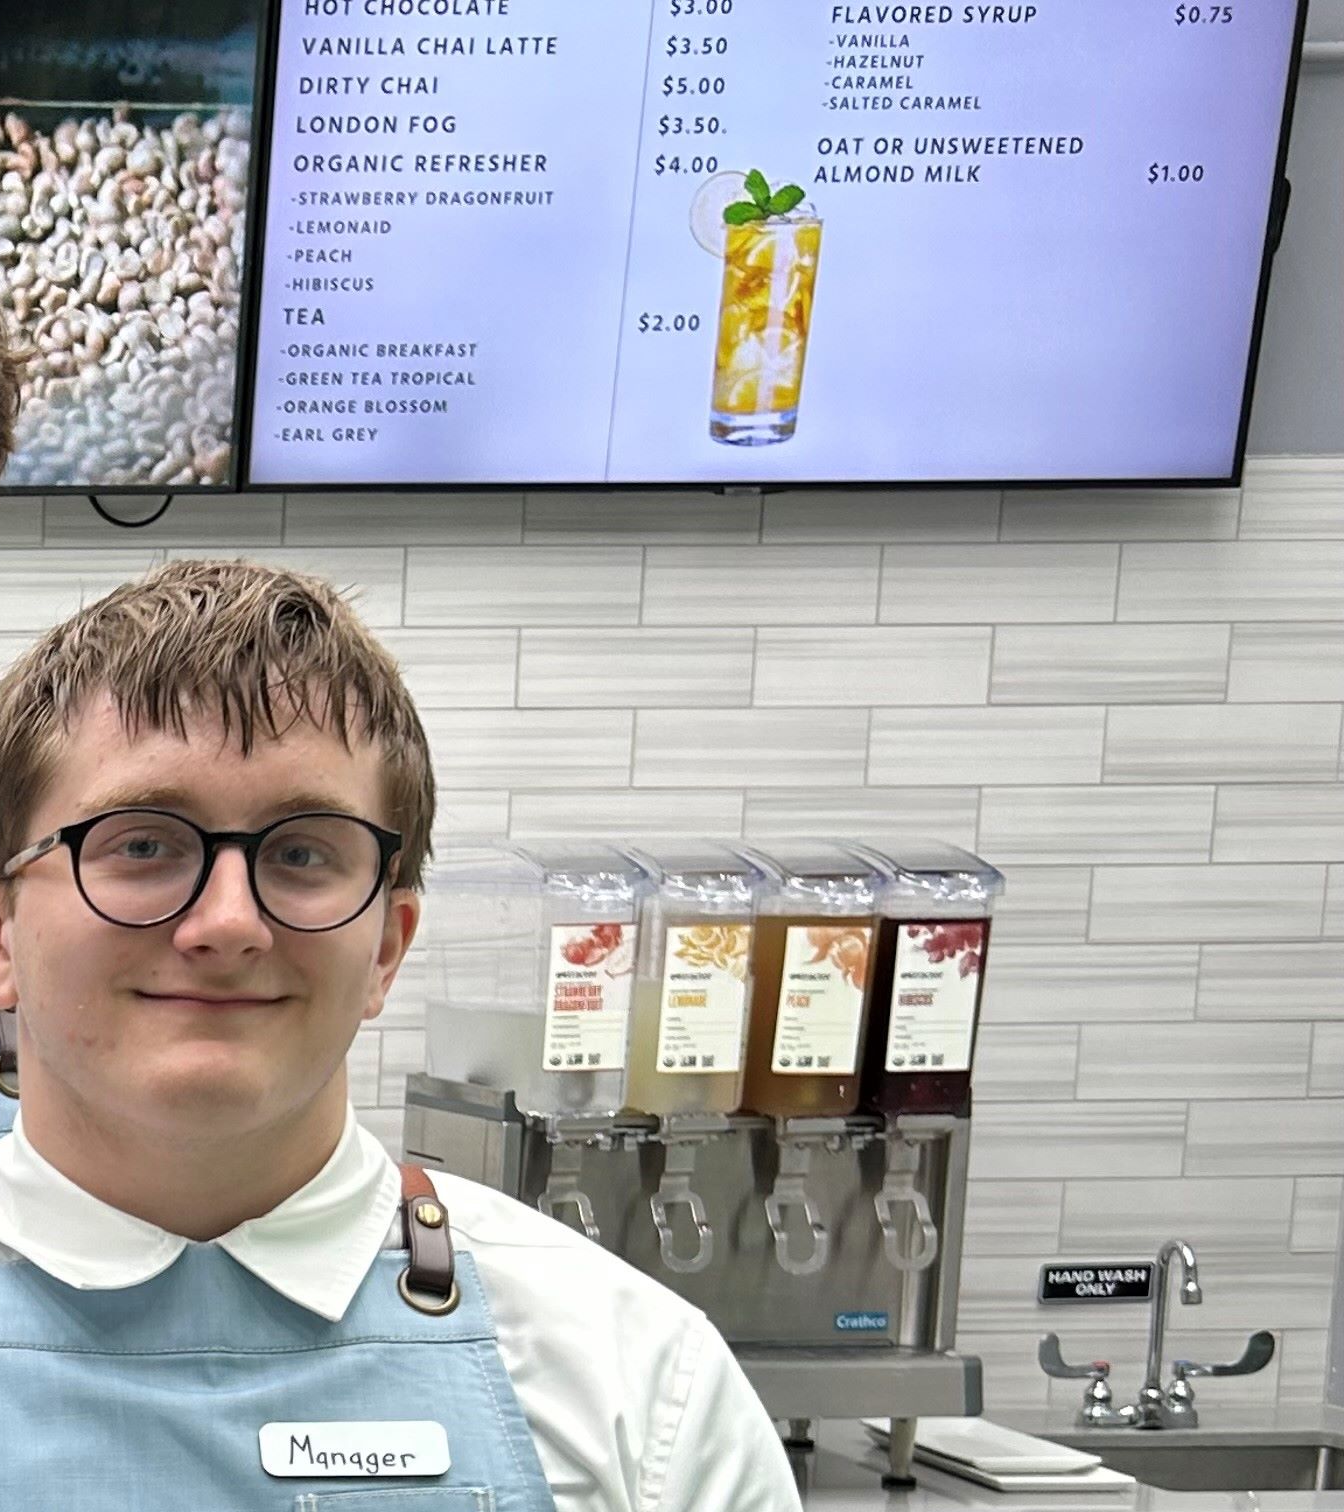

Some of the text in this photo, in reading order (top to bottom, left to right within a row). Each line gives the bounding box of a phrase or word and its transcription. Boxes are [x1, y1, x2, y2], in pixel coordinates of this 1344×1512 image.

[305, 0, 508, 15] HOT CHOCOLATE
[671, 0, 732, 17] $3.00
[832, 6, 1036, 23] FLAVORED SYRUP
[1175, 4, 1232, 25] $0.75
[302, 37, 557, 55] VANILLA CHAI LATTE
[666, 35, 727, 57] $3.50
[300, 77, 437, 95] DIRTY CHAI
[663, 75, 725, 97] $5.00
[900, 96, 981, 110] CARAMEL
[297, 116, 456, 133] LONDON FOG
[818, 137, 1083, 155] OAT OR UNSWEETENED
[294, 154, 547, 172] ORGANIC REFRESHER
[655, 154, 718, 176] $4.00
[814, 165, 980, 183] ALMOND MILK
[1148, 163, 1204, 184] $1.00
[426, 191, 554, 205] DRAGONFRUIT
[283, 308, 325, 325] TEA
[638, 312, 700, 333] $2.00
[377, 344, 477, 357] BREAKFAST
[351, 372, 382, 385] TEA
[391, 372, 475, 385] TROPICAL
[365, 400, 447, 413] BLOSSOM
[332, 428, 378, 441] GREY
[1048, 1269, 1146, 1284] HAND WASH
[1075, 1282, 1116, 1296] ONLY
[289, 1434, 416, 1475] Manager
